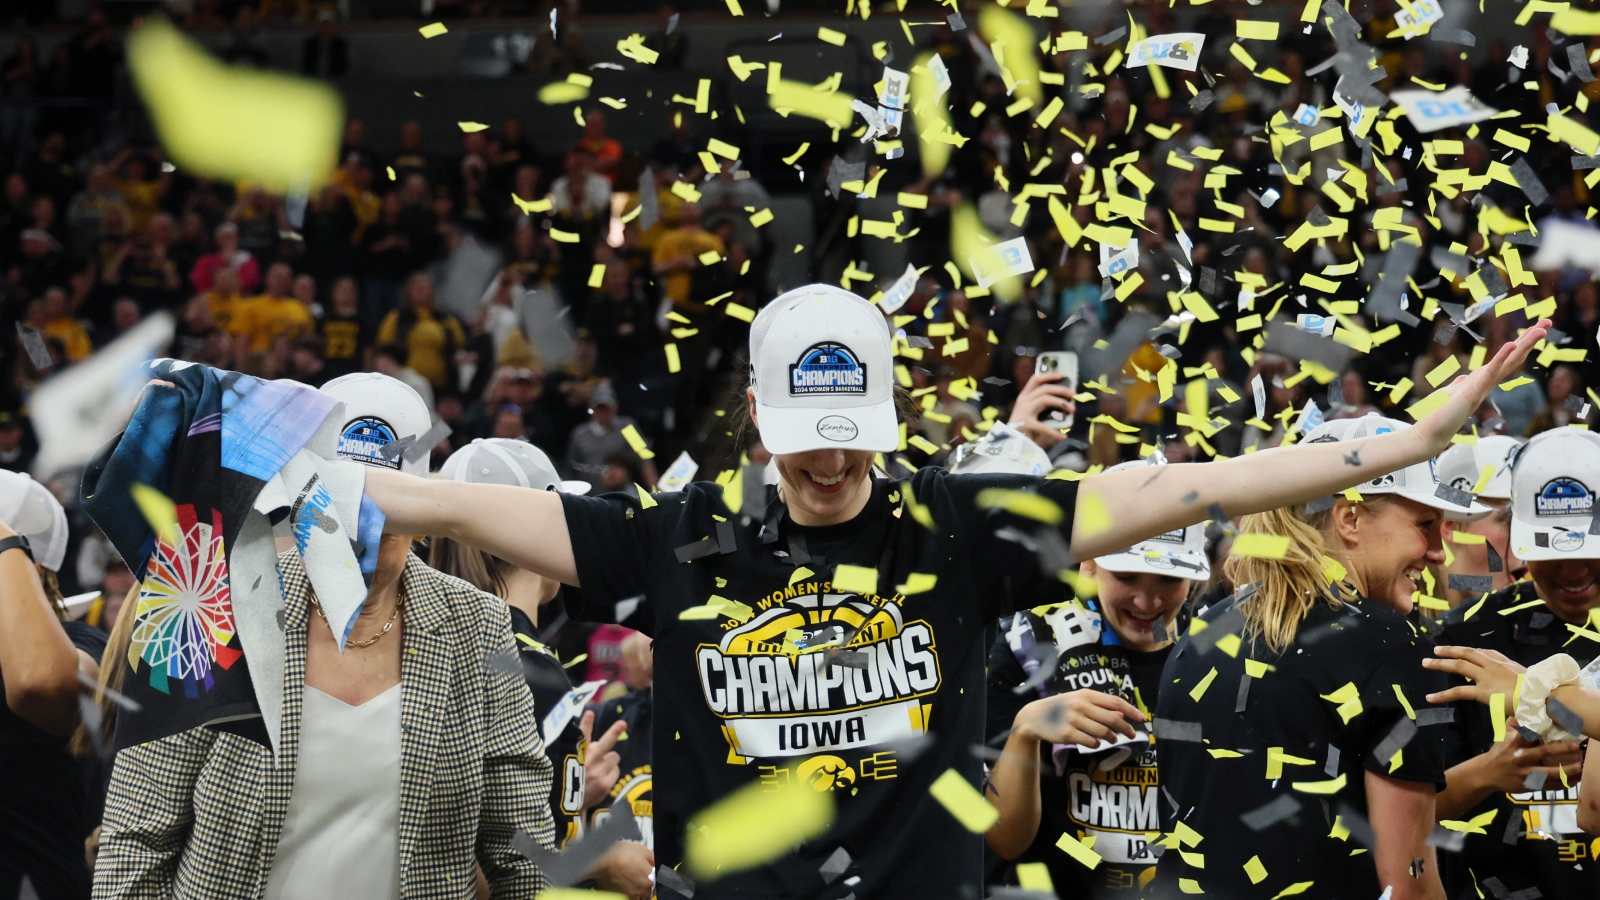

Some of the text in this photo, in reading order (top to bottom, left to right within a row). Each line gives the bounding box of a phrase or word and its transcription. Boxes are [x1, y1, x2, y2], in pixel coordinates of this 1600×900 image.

[793, 367, 864, 387] CHAMPIONS
[371, 457, 399, 469] BASKEBALL
[1537, 494, 1594, 510] CHAMPIONS
[757, 582, 832, 611] WOMEN'S
[698, 624, 938, 713] CHAMPIONS
[778, 716, 867, 751] IOWA
[1069, 772, 1160, 831] CHAM
